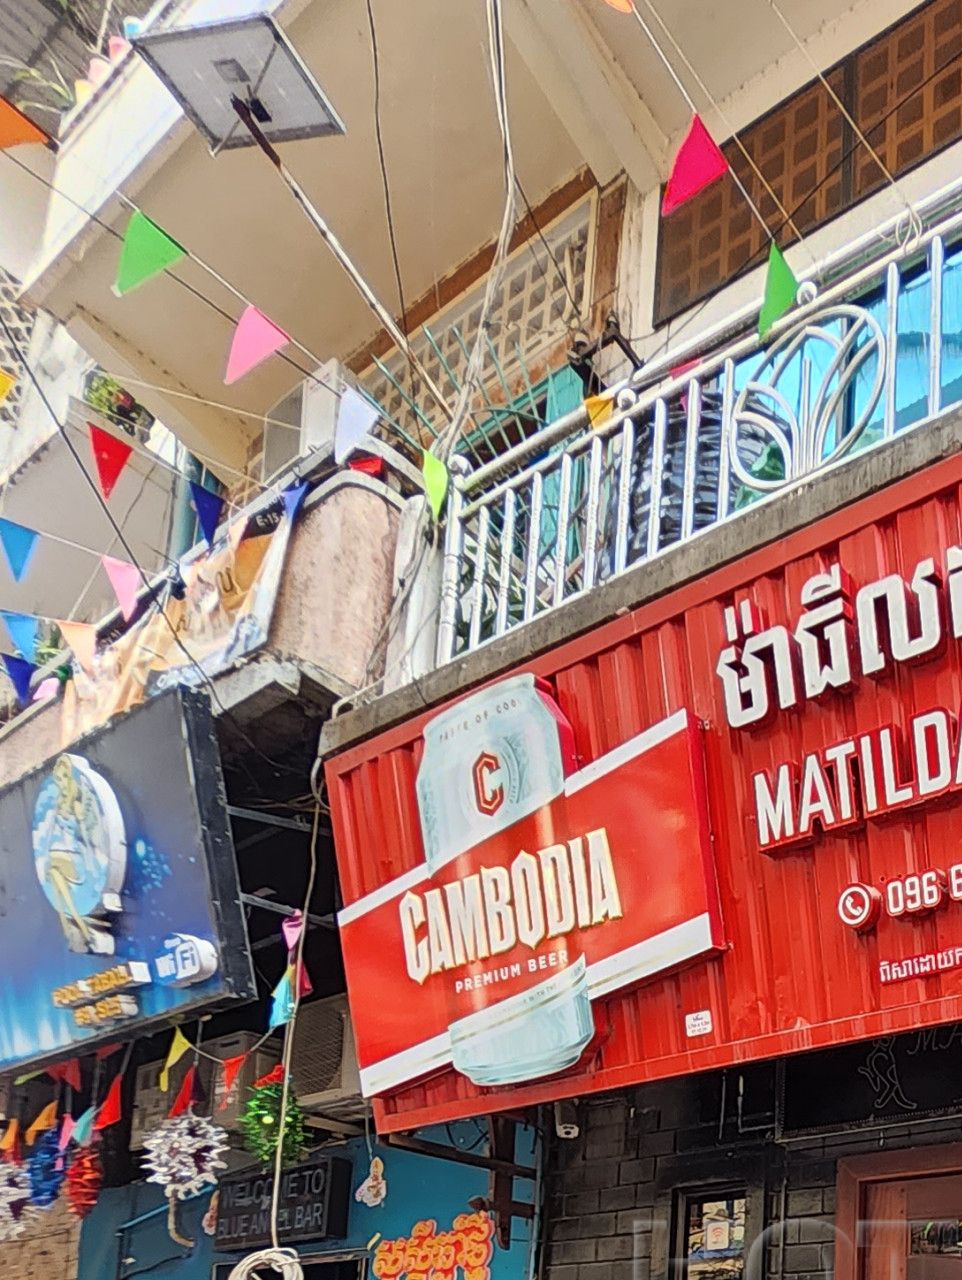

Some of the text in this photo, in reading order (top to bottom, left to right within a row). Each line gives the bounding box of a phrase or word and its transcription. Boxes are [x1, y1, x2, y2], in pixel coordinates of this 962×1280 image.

[495, 699, 520, 714] COO
[472, 751, 504, 816] C
[398, 827, 623, 984] CAMBODIA
[887, 871, 938, 915] 096
[454, 963, 522, 994] PREMIUM
[527, 949, 569, 973] BEER
[302, 1168, 325, 1197] TO
[250, 1209, 292, 1235] ANEL
[294, 1202, 323, 1228] BAR
